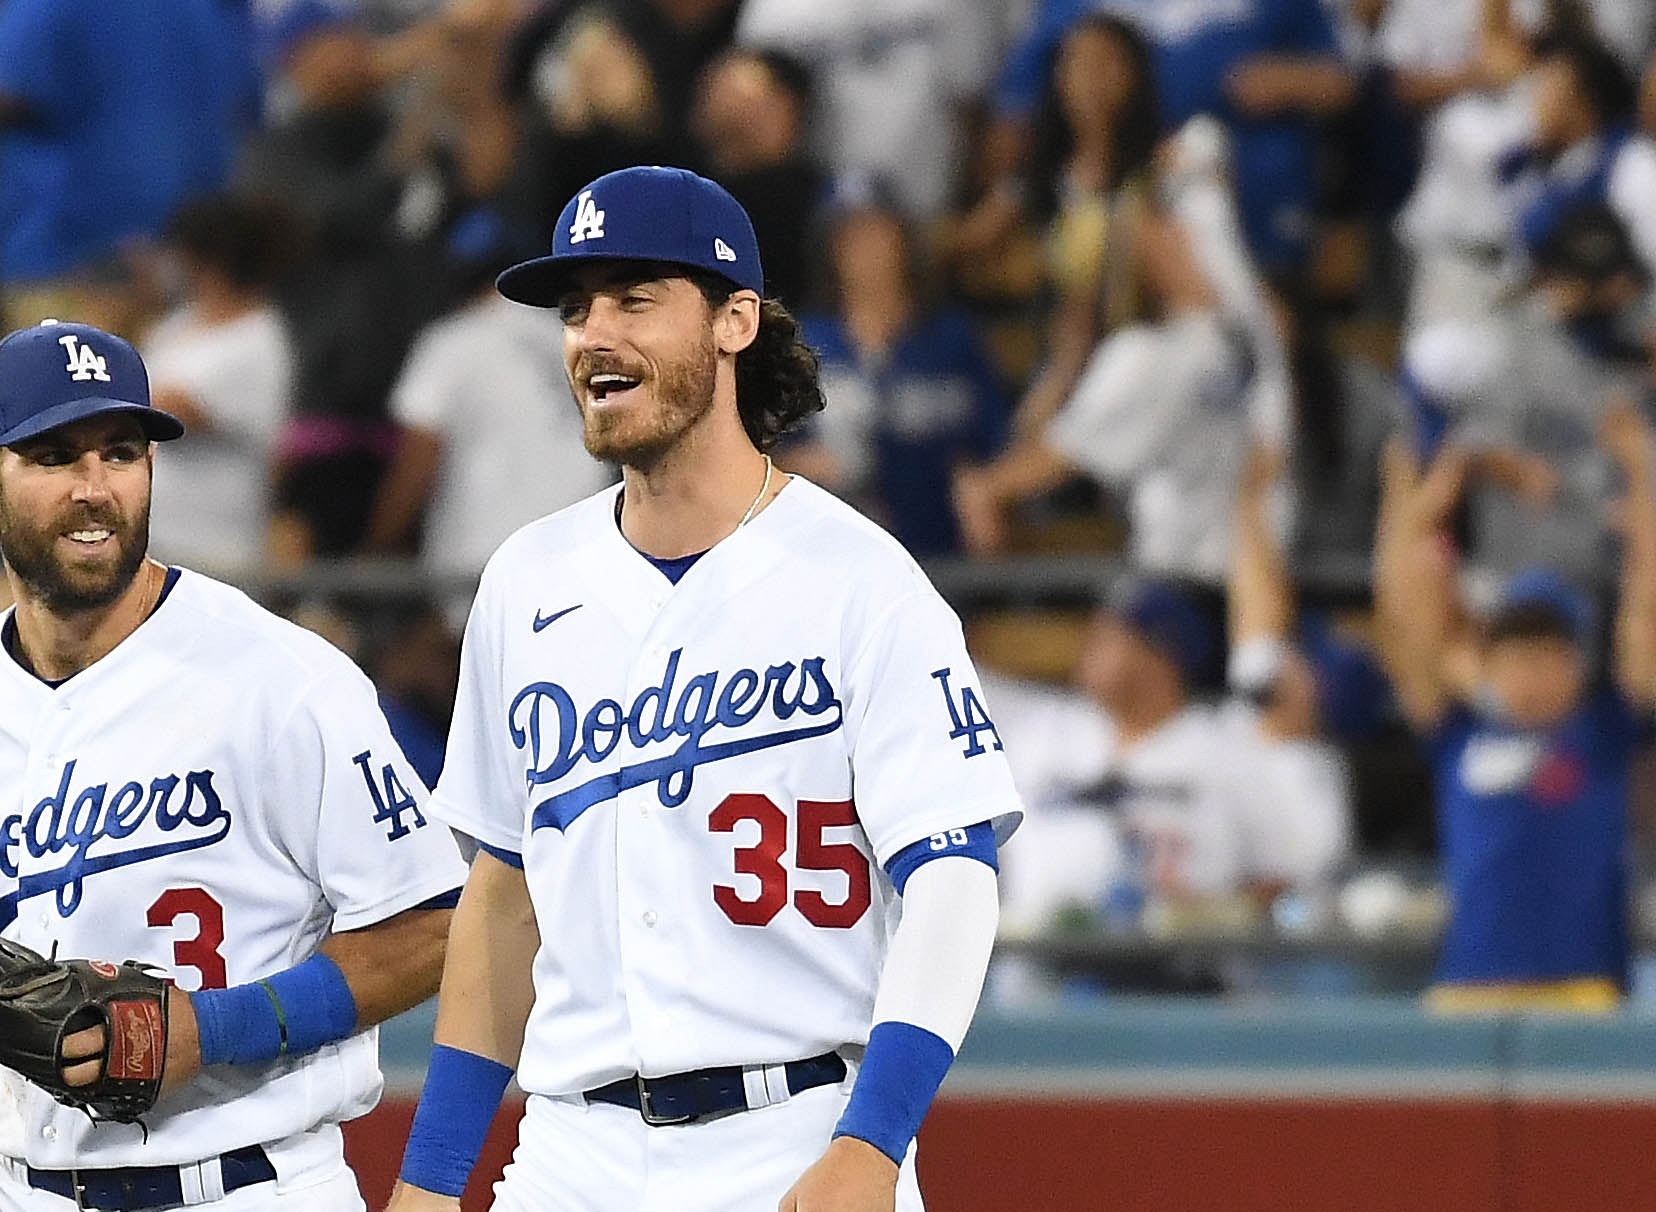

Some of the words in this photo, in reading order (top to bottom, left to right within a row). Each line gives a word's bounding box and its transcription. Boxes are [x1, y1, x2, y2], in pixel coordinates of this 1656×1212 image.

[569, 189, 606, 245] LA
[57, 334, 112, 383] LA
[508, 647, 841, 809] Dodgers
[931, 667, 1005, 760] LA
[352, 749, 429, 843] LA
[707, 792, 873, 930] 35
[145, 886, 229, 990] 3
